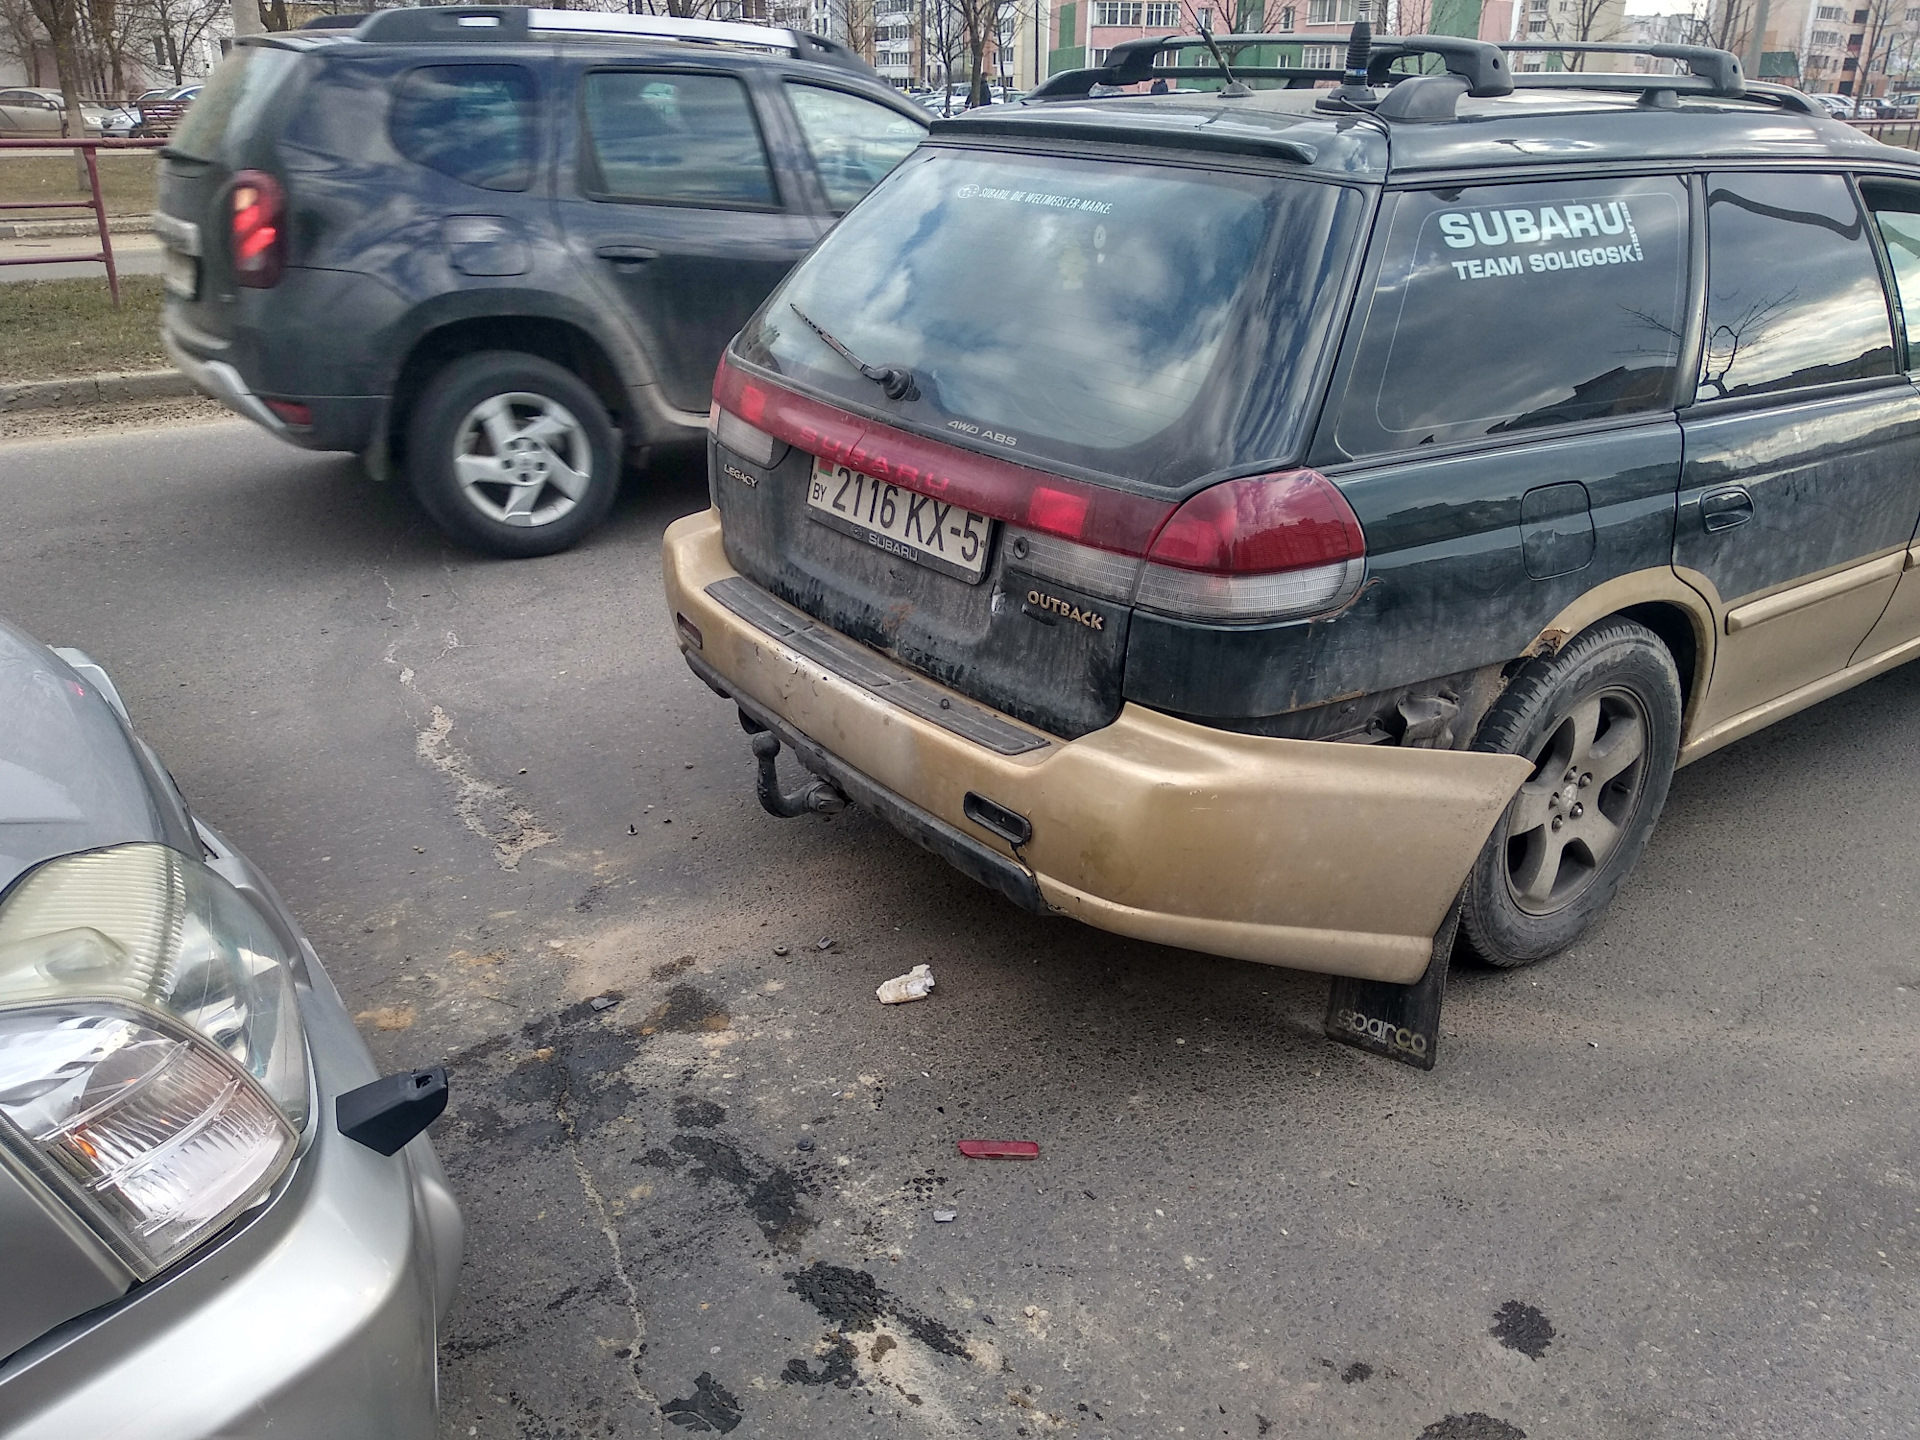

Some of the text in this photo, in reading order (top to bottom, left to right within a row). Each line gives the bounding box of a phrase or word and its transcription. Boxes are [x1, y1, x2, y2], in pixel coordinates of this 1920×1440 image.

[1010, 190, 1027, 202] DIE
[1438, 201, 1625, 249] SUBARU
[1451, 244, 1637, 281] TEAM SOLIGOSK
[947, 420, 1018, 446] 4WD ABS
[800, 426, 950, 491] SUBARU
[724, 463, 758, 488] LEGACY
[812, 482, 828, 503] BY
[832, 467, 984, 562] 2116 KX-5
[868, 533, 919, 562] SUBARU
[1027, 590, 1103, 630] OUTBACK
